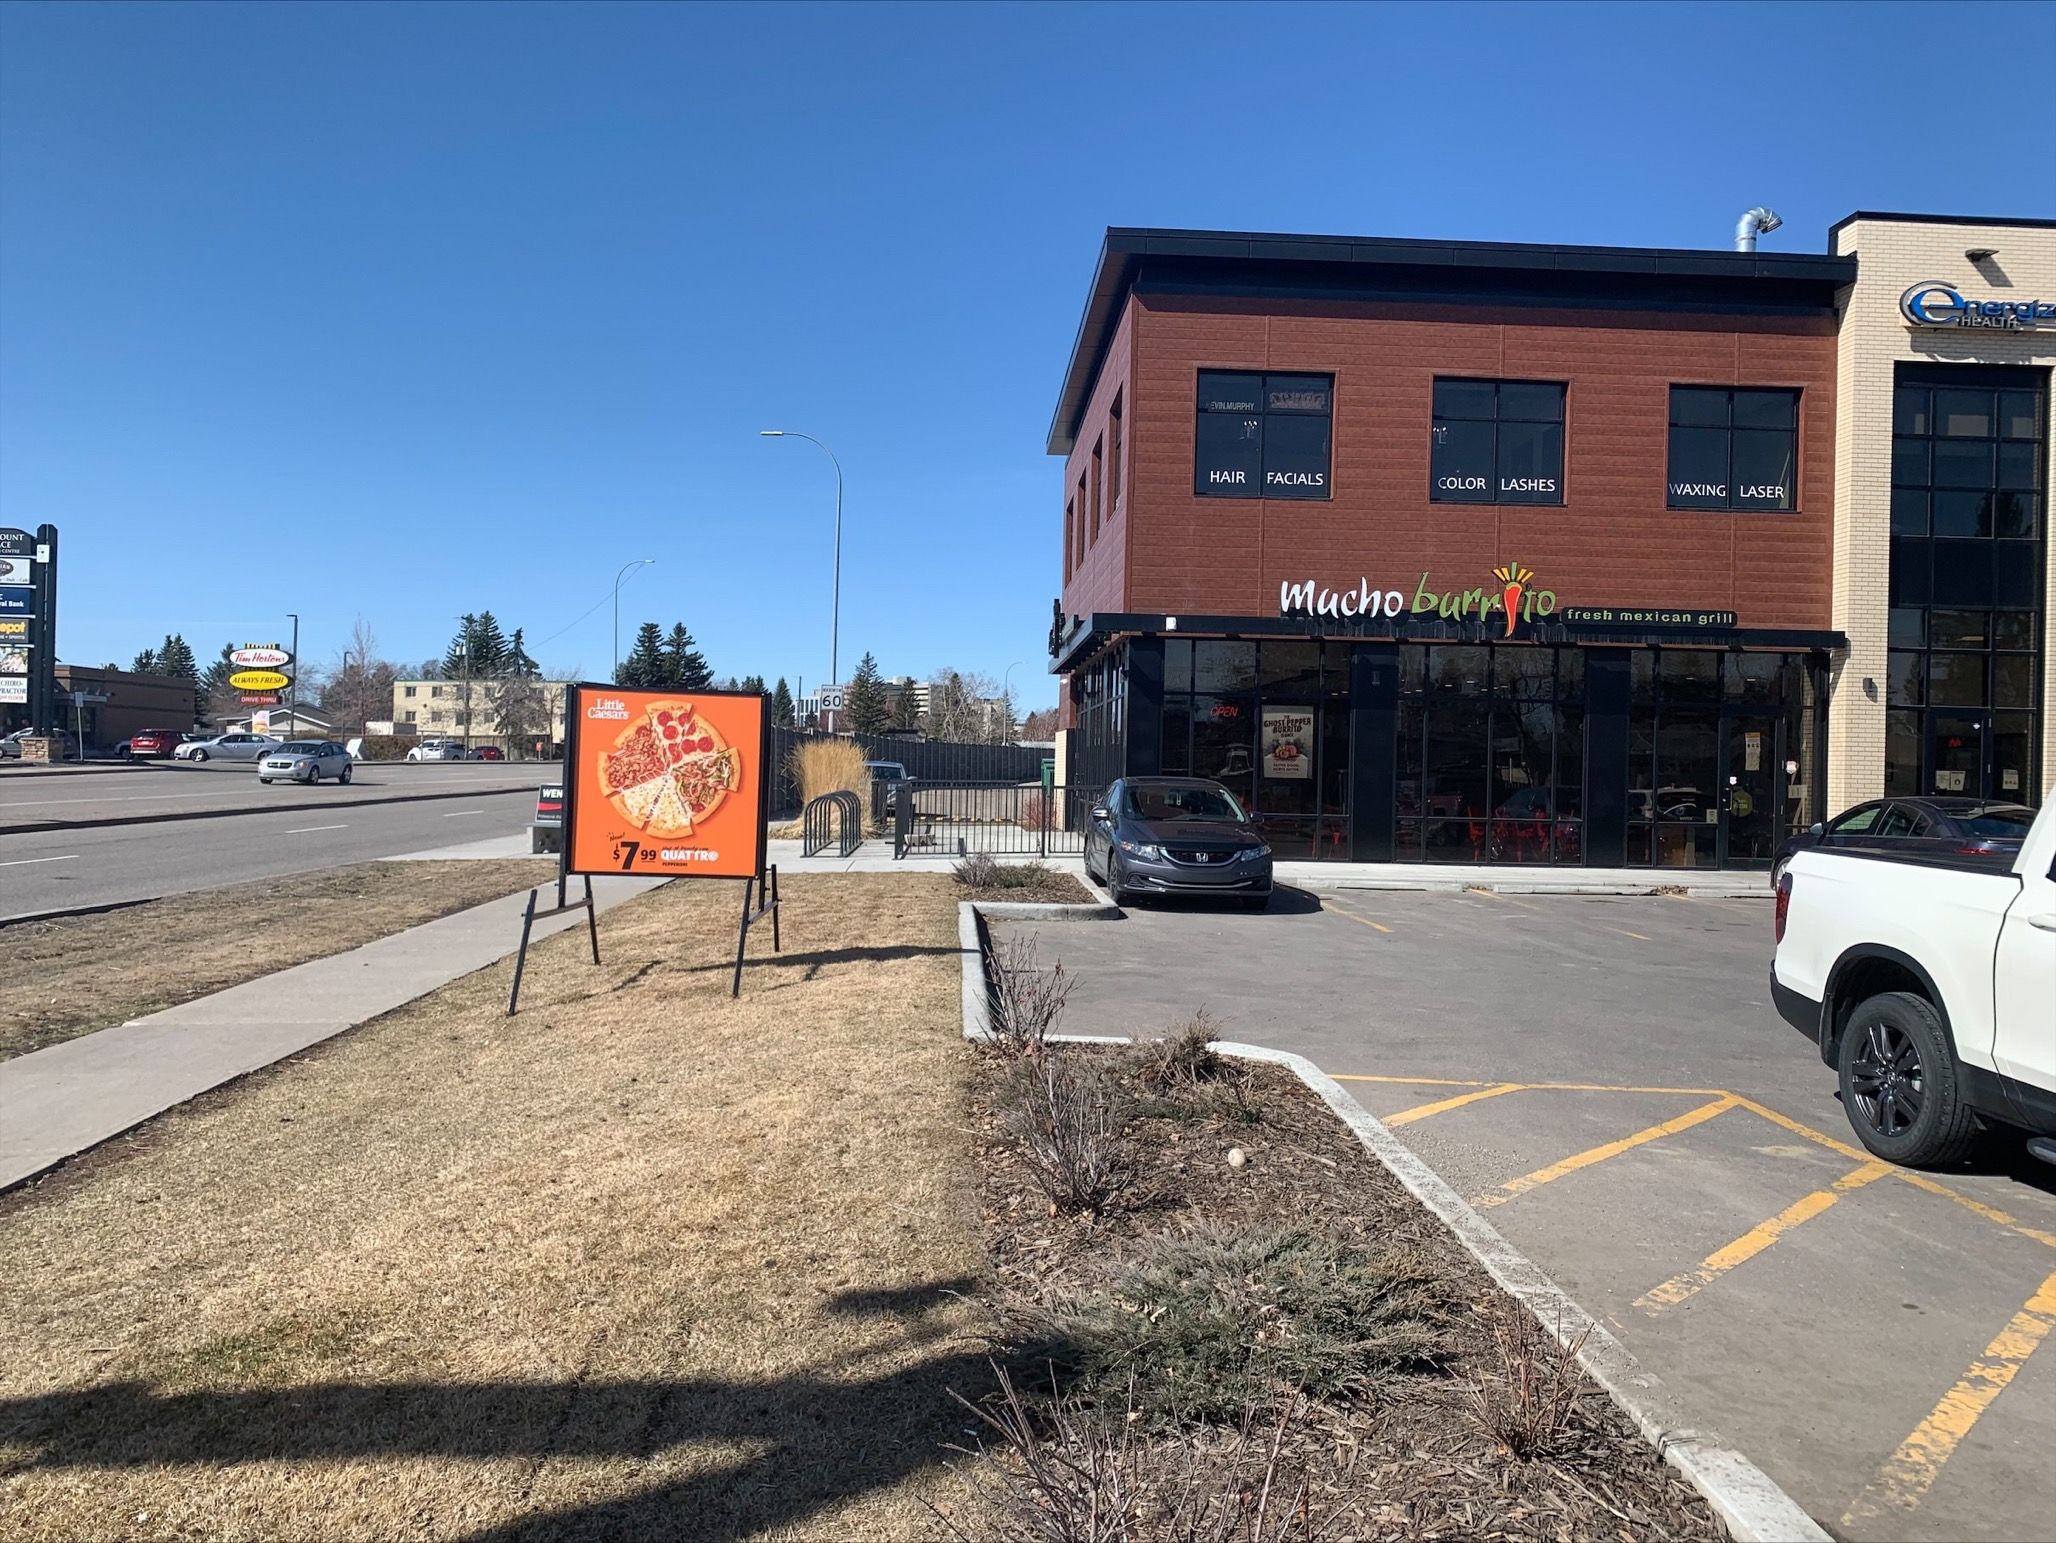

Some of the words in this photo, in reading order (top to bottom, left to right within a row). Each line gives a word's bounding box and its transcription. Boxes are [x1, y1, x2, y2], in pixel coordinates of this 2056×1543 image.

[1961, 317, 2019, 328] HEALTH
[1209, 401, 1255, 411] EVIN.MURPHY
[1210, 470, 1246, 484] HAIR
[1267, 472, 1324, 486] FACIALS
[1438, 477, 1486, 490] COLOR
[1501, 478, 1556, 492] LASHES
[1669, 483, 1726, 496] WAXING
[1740, 485, 1784, 498] LASER
[1281, 577, 1404, 619] Mucho
[1411, 561, 1557, 637] burrito
[1567, 609, 1613, 620] fresh
[1620, 611, 1692, 622] mexican
[1698, 613, 1733, 625] grill
[235, 652, 251, 662] Tim
[252, 652, 285, 663] Hortons
[596, 699, 625, 710] Little
[823, 695, 841, 707] 60
[587, 708, 630, 719] Caesars
[1210, 707, 1238, 718] OPEN
[1264, 720, 1285, 728] GHOST
[1286, 718, 1312, 726] PEPPER
[542, 789, 563, 798] WEN
